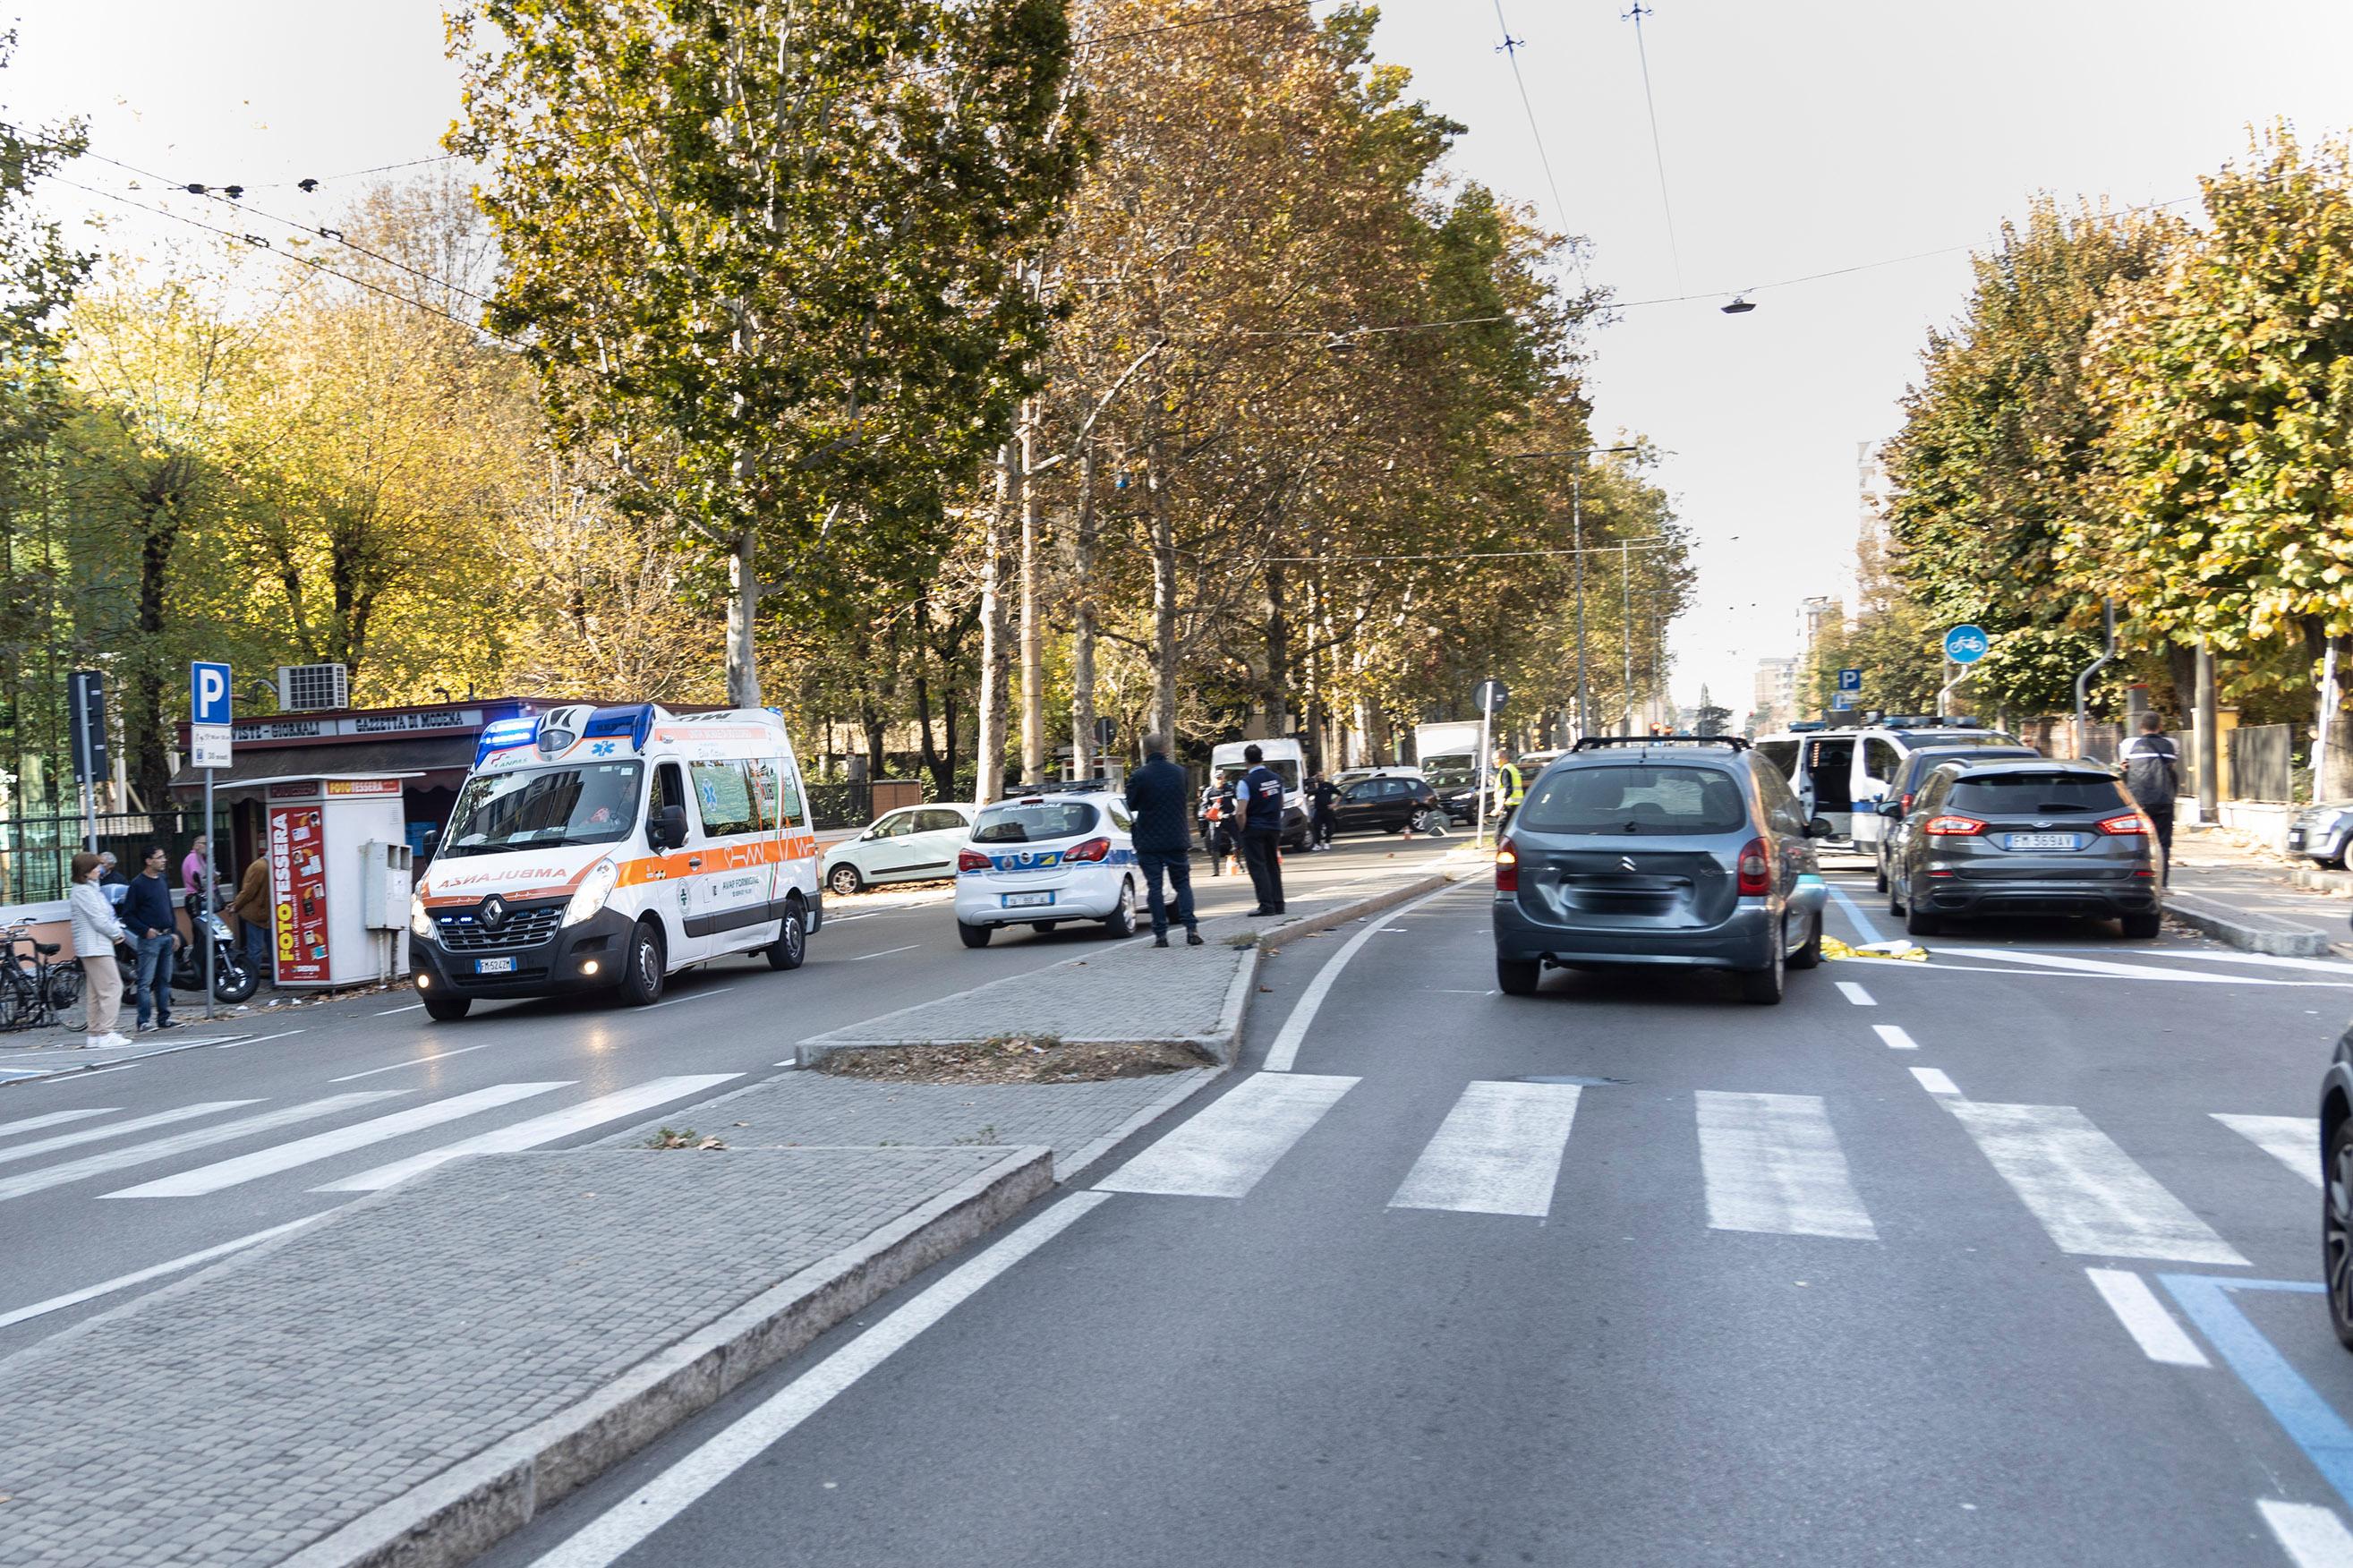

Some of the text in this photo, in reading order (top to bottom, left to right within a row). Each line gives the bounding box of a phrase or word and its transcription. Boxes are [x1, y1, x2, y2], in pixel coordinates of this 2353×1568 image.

[1842, 671, 1857, 688] P
[200, 669, 224, 718] P
[232, 724, 261, 740] VISTE
[271, 721, 320, 737] GIORNALI
[356, 712, 464, 732] GAZZETTA DI MODENA
